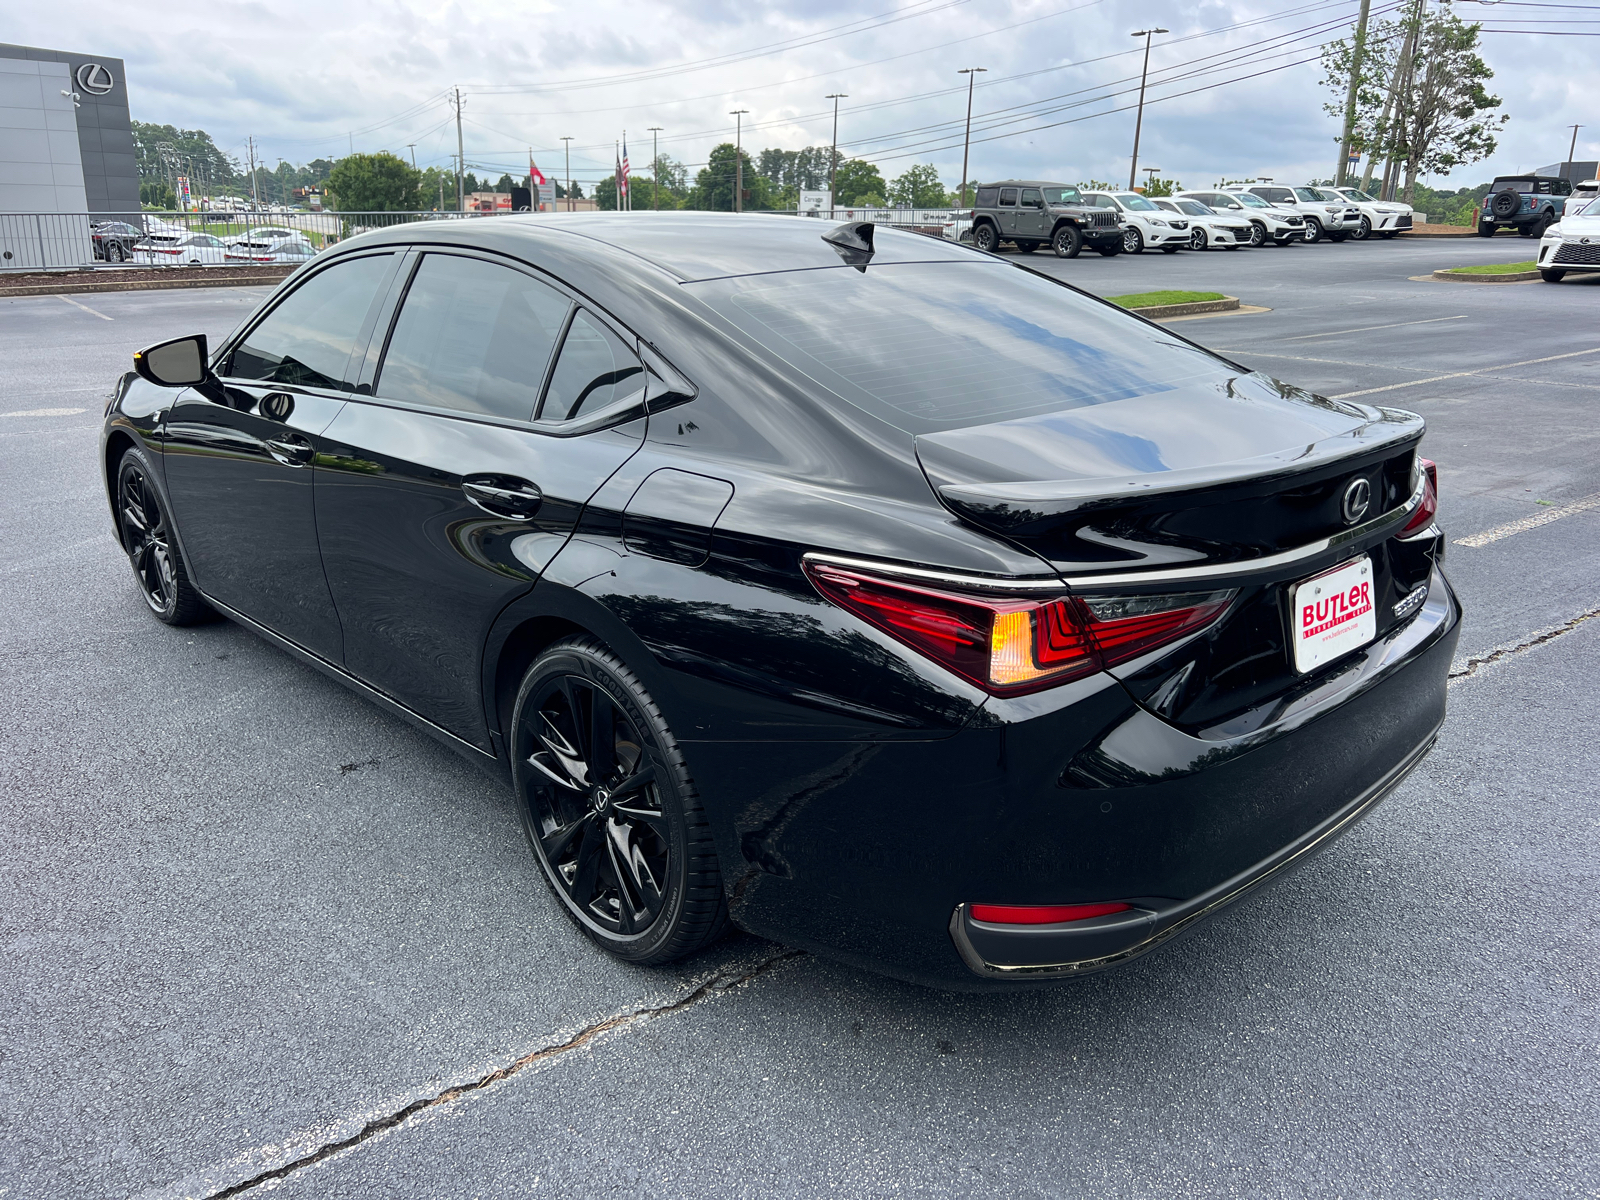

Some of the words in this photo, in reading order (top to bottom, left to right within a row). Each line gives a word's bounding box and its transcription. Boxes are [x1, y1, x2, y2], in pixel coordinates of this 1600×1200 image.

[1303, 614, 1348, 640] AUTOMOTIVE
[1352, 603, 1372, 618] GROUP
[595, 669, 650, 737] GOODYEAR
